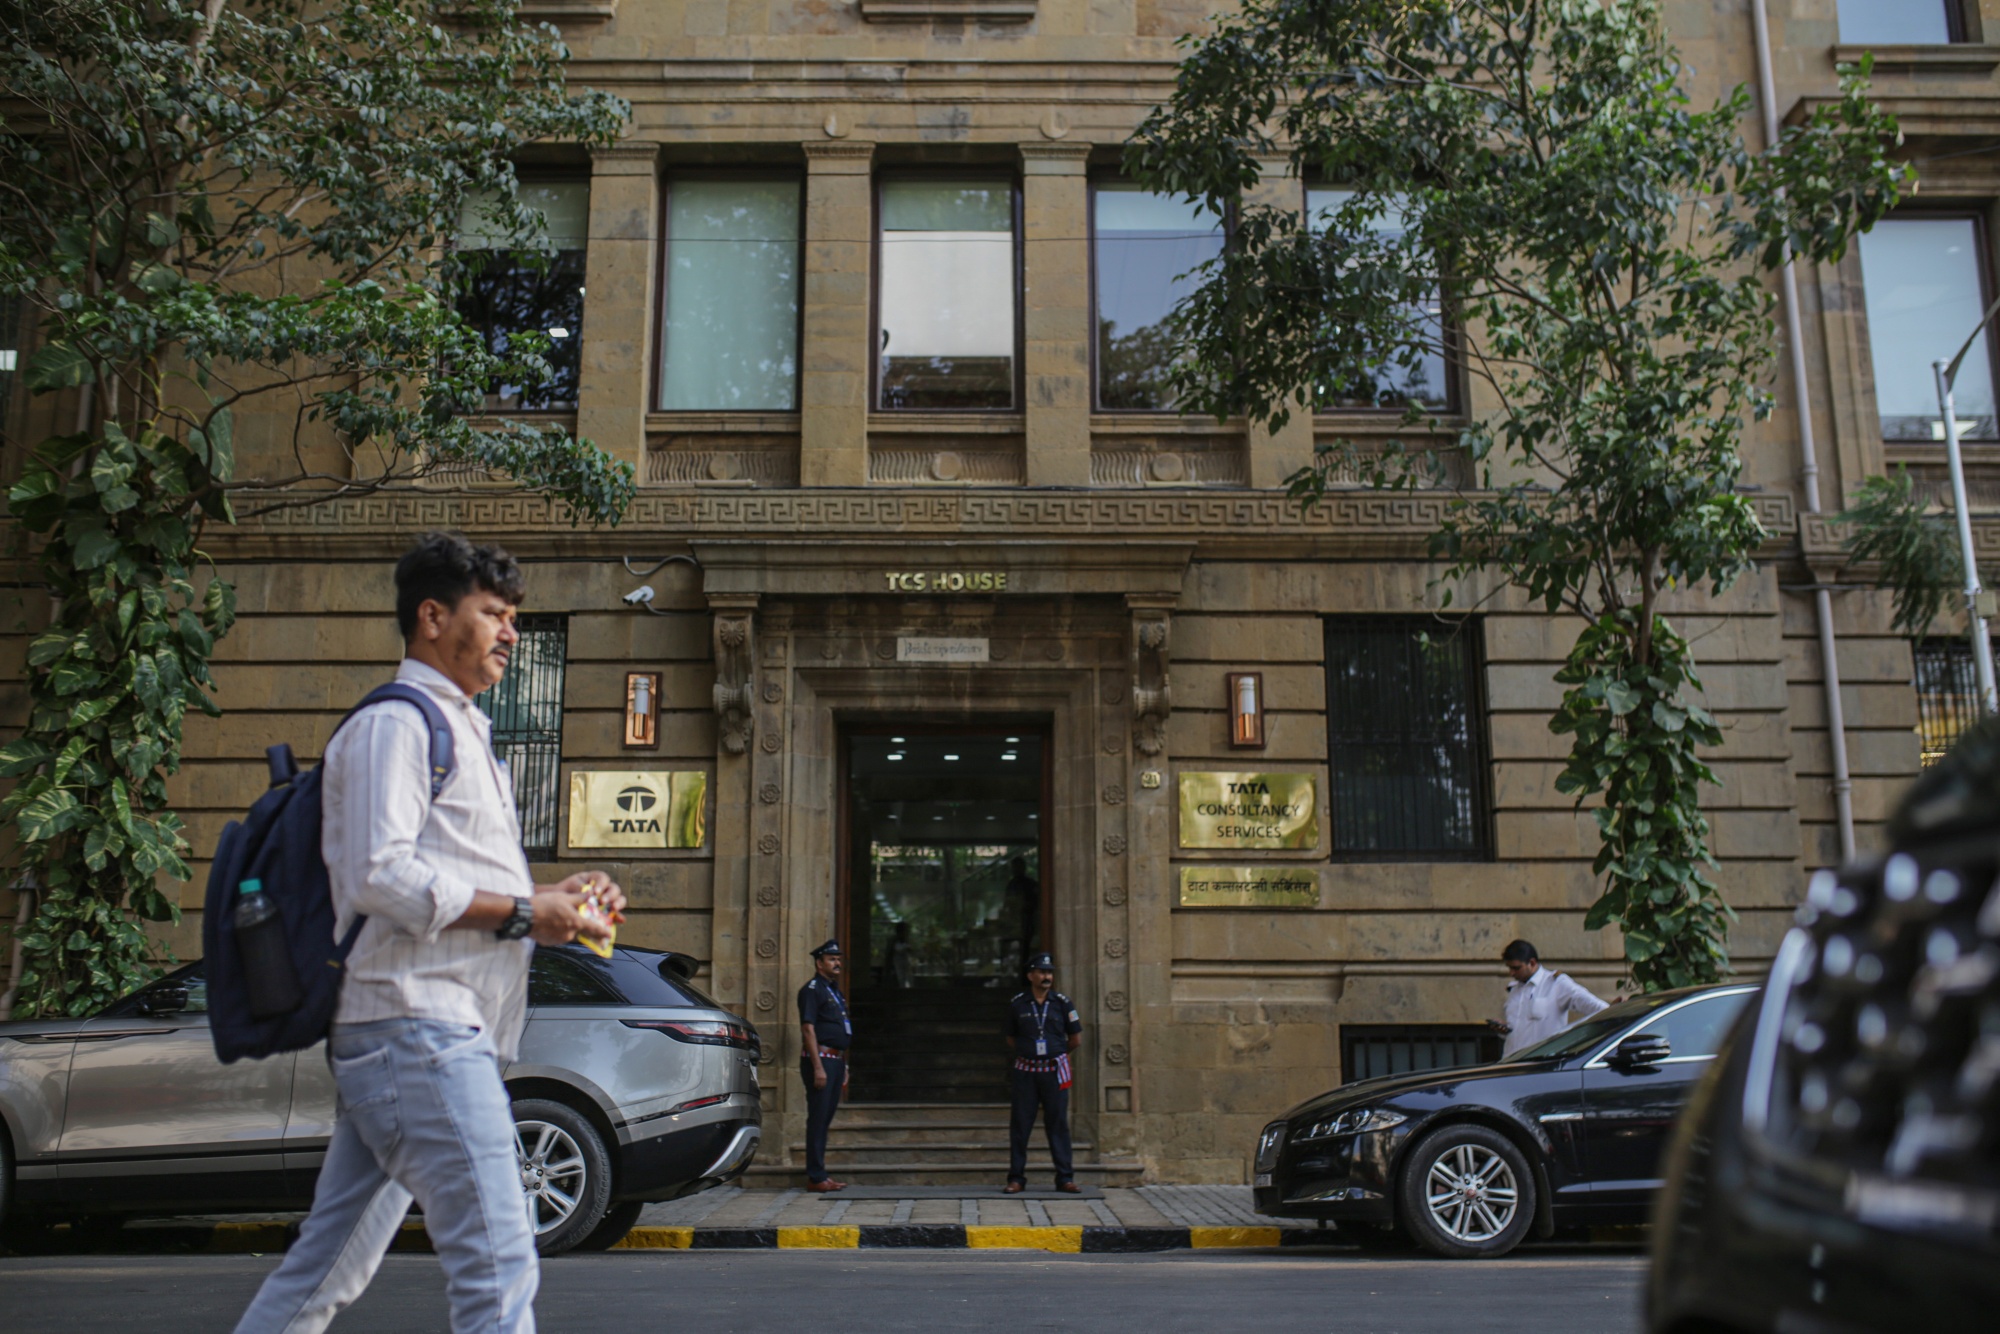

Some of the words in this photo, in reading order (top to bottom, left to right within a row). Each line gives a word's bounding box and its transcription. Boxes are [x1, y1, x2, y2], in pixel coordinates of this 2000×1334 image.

[886, 572, 927, 591] TCS
[931, 572, 1007, 591] HOUSE
[1227, 783, 1270, 795] TATA
[1197, 804, 1300, 817] CONSULTANCY
[609, 819, 661, 833] TATA
[1217, 825, 1282, 839] SERVICES
[1188, 880, 1209, 892] टाटा
